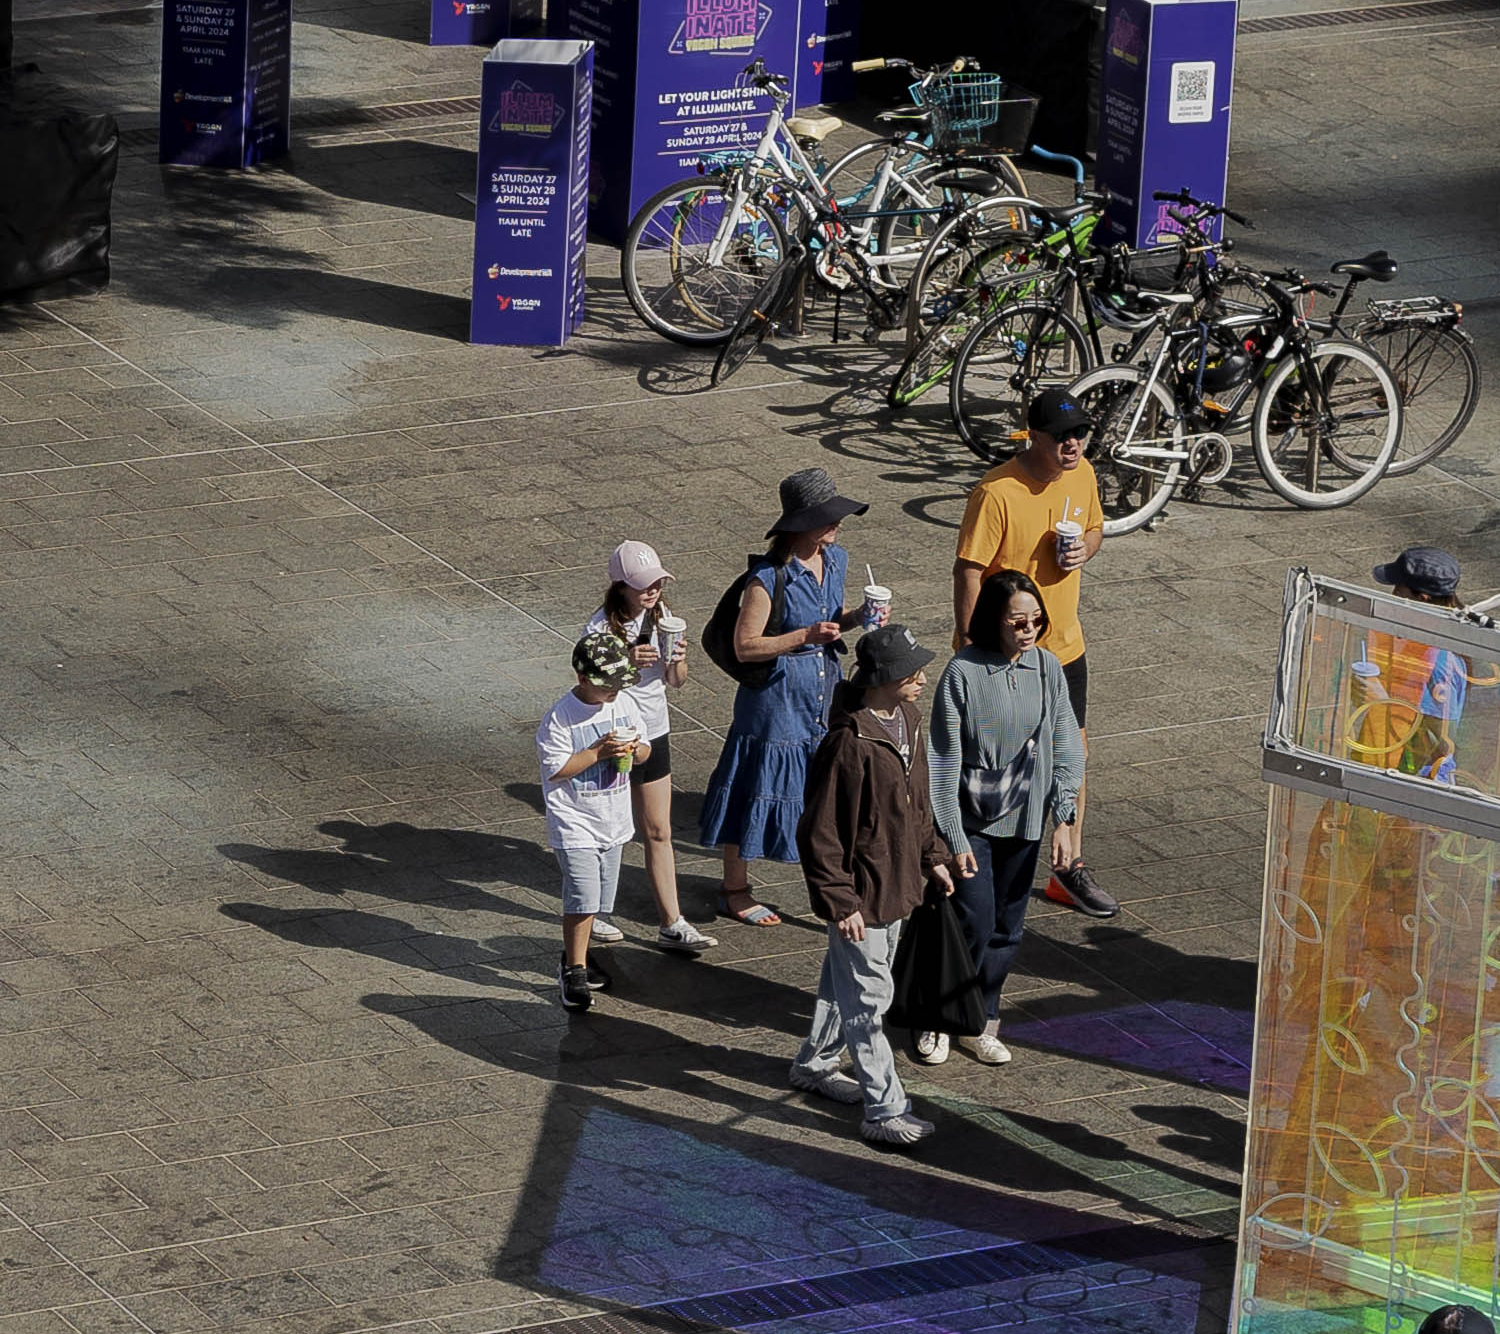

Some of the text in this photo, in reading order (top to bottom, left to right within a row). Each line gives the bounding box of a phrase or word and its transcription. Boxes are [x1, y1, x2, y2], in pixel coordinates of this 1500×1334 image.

[686, 13, 756, 39] INATE
[658, 92, 676, 105] LET
[679, 91, 709, 103] YOUR
[710, 89, 742, 101] LIGHT
[677, 107, 690, 116] AT
[684, 125, 729, 136] SATURDAY
[667, 137, 703, 147] SUNDAY
[705, 136, 715, 144] 28
[743, 131, 762, 141] 2024
[491, 173, 557, 184] SATURDAY 27
[492, 185, 556, 195] & SUNDAY 28
[495, 196, 550, 205] APRIL 2024
[498, 217, 546, 227] 11AM UNTIL
[511, 228, 532, 237] LATE
